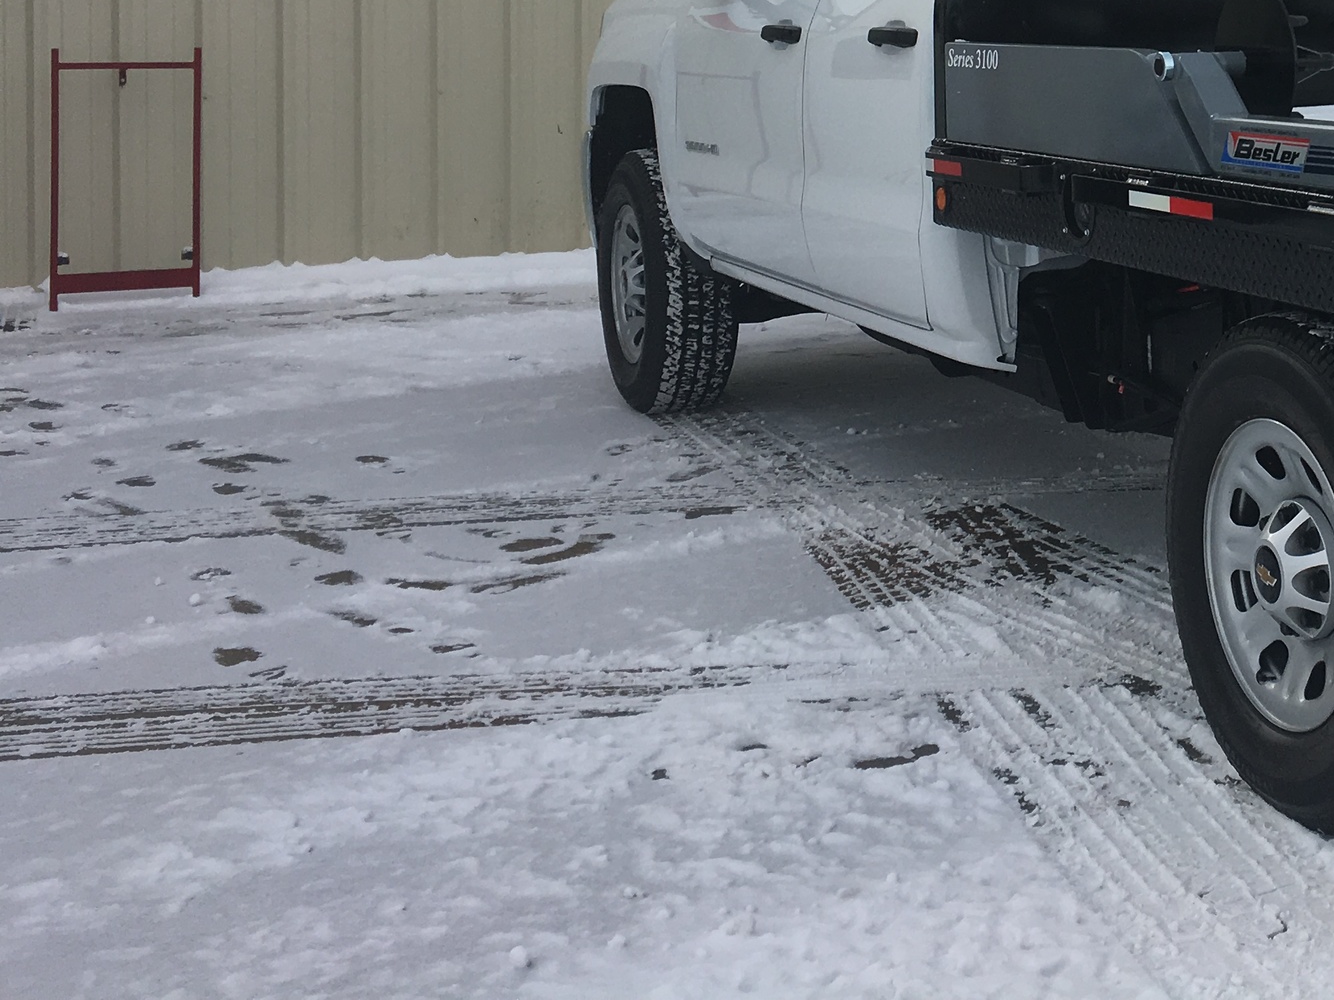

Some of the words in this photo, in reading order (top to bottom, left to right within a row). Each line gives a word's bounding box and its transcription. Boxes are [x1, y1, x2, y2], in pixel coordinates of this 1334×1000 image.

[947, 48, 974, 68] Series
[975, 48, 999, 70] 3100
[1233, 138, 1300, 165] Besler
